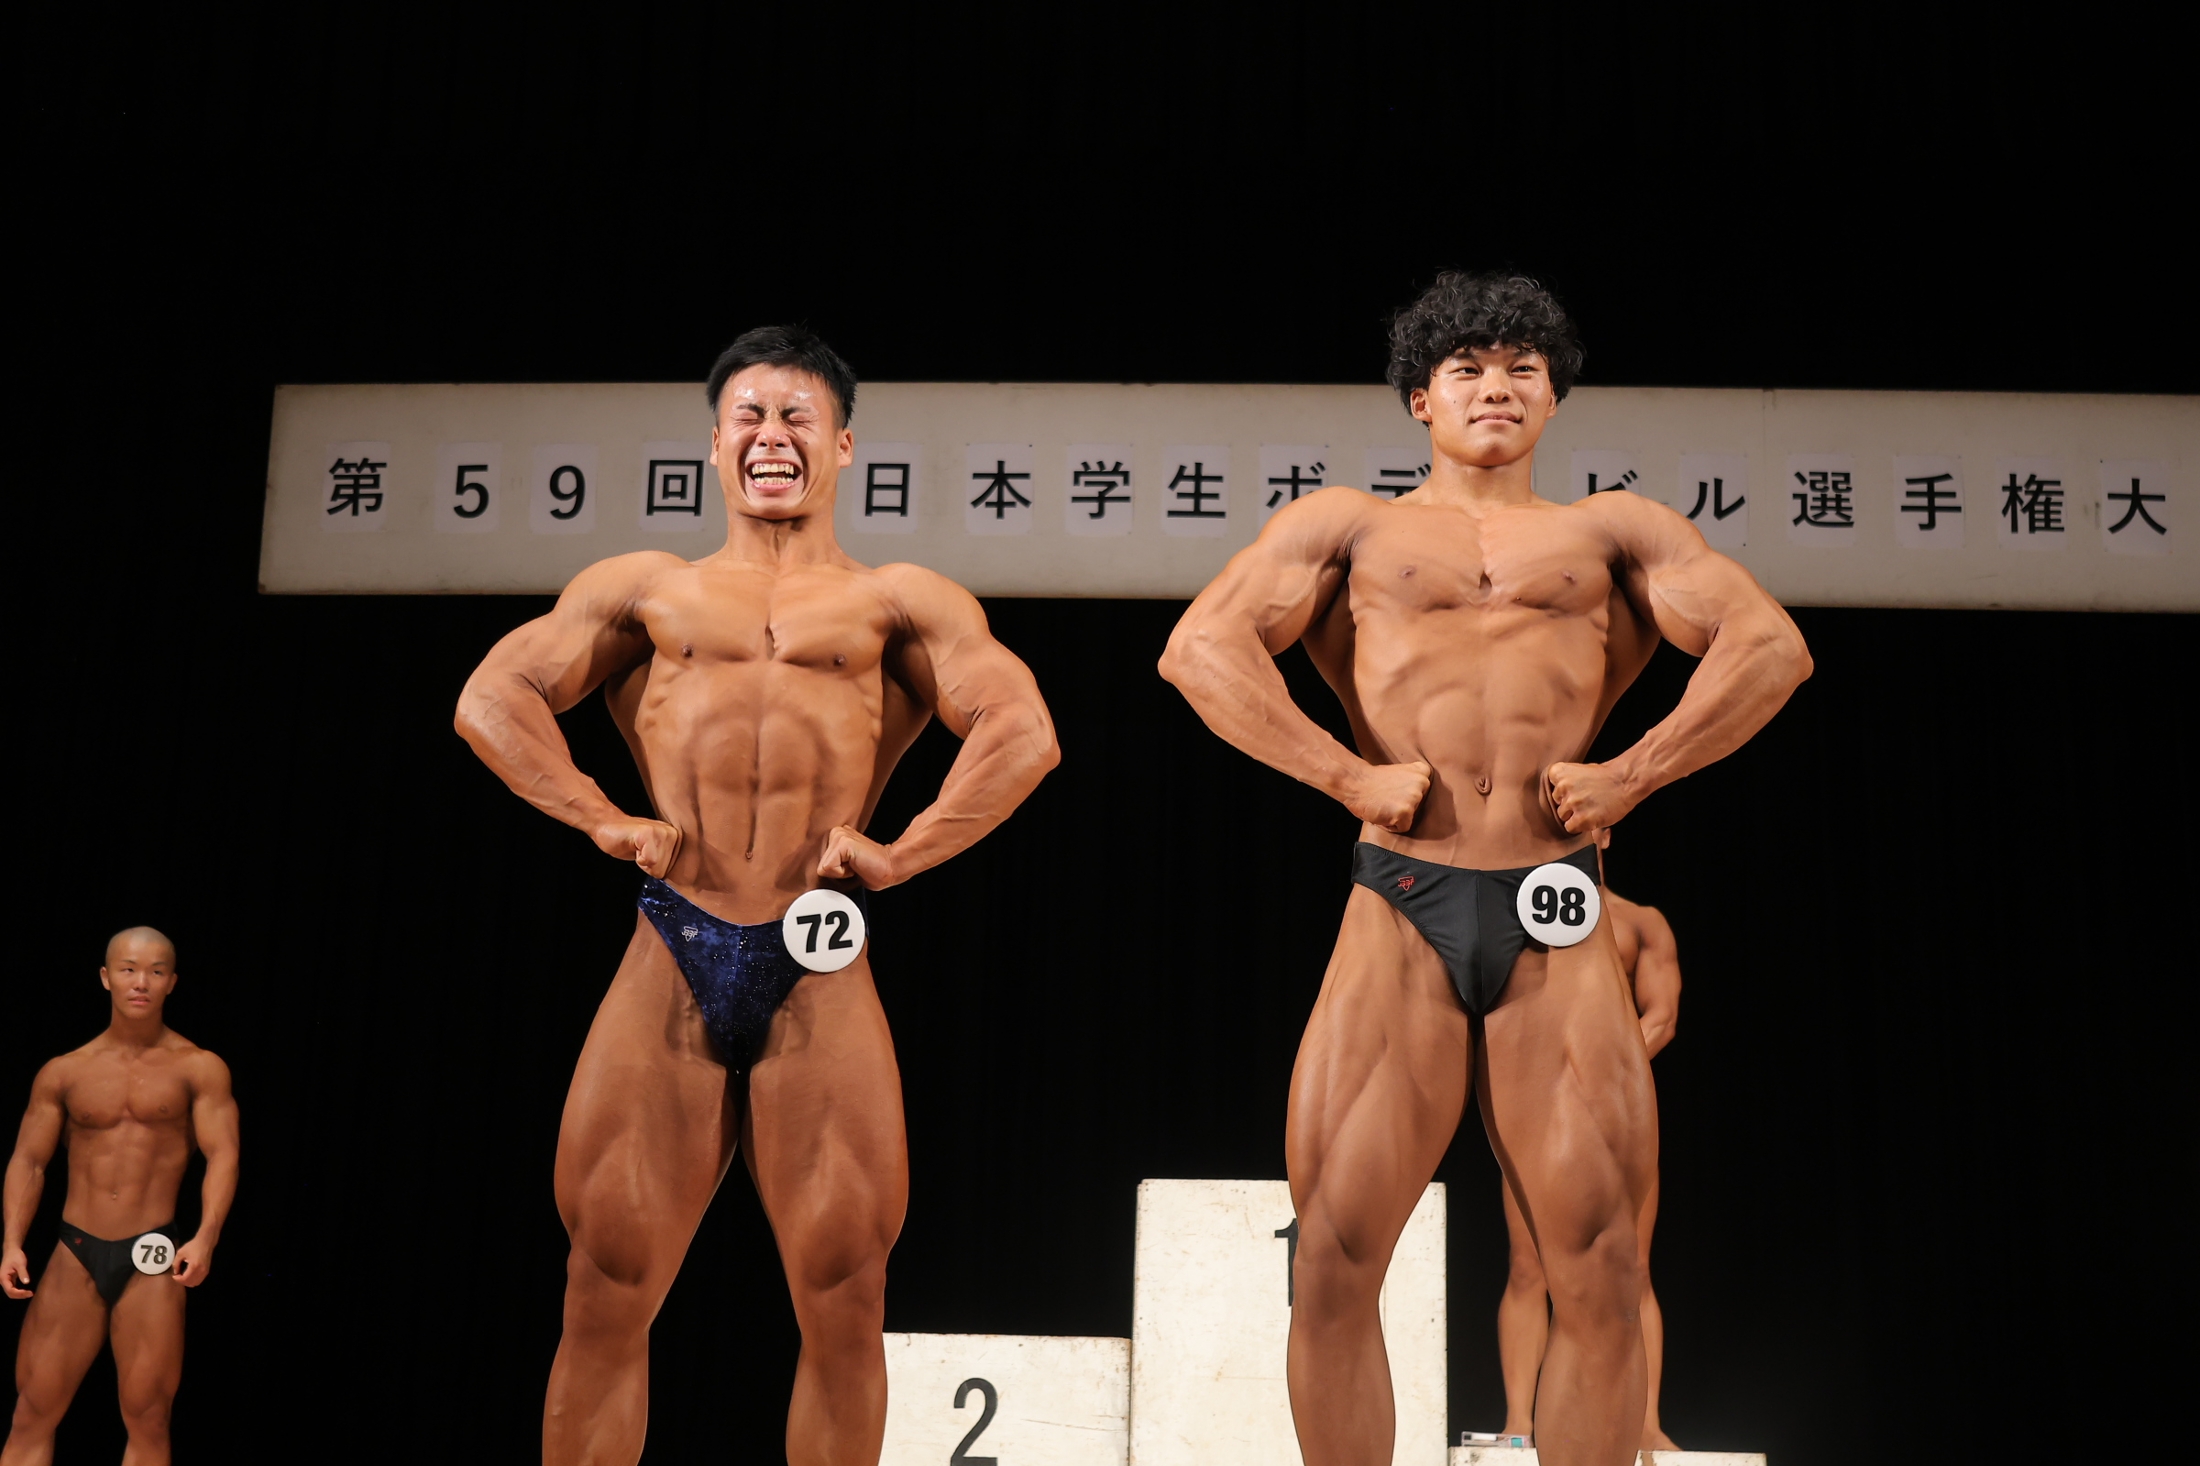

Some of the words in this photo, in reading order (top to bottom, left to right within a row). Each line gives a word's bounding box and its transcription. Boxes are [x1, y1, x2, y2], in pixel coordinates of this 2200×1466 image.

[1532, 885, 1585, 926] 98
[796, 910, 853, 953] 72
[141, 1245, 168, 1264] 78
[950, 1377, 998, 1466] 2
